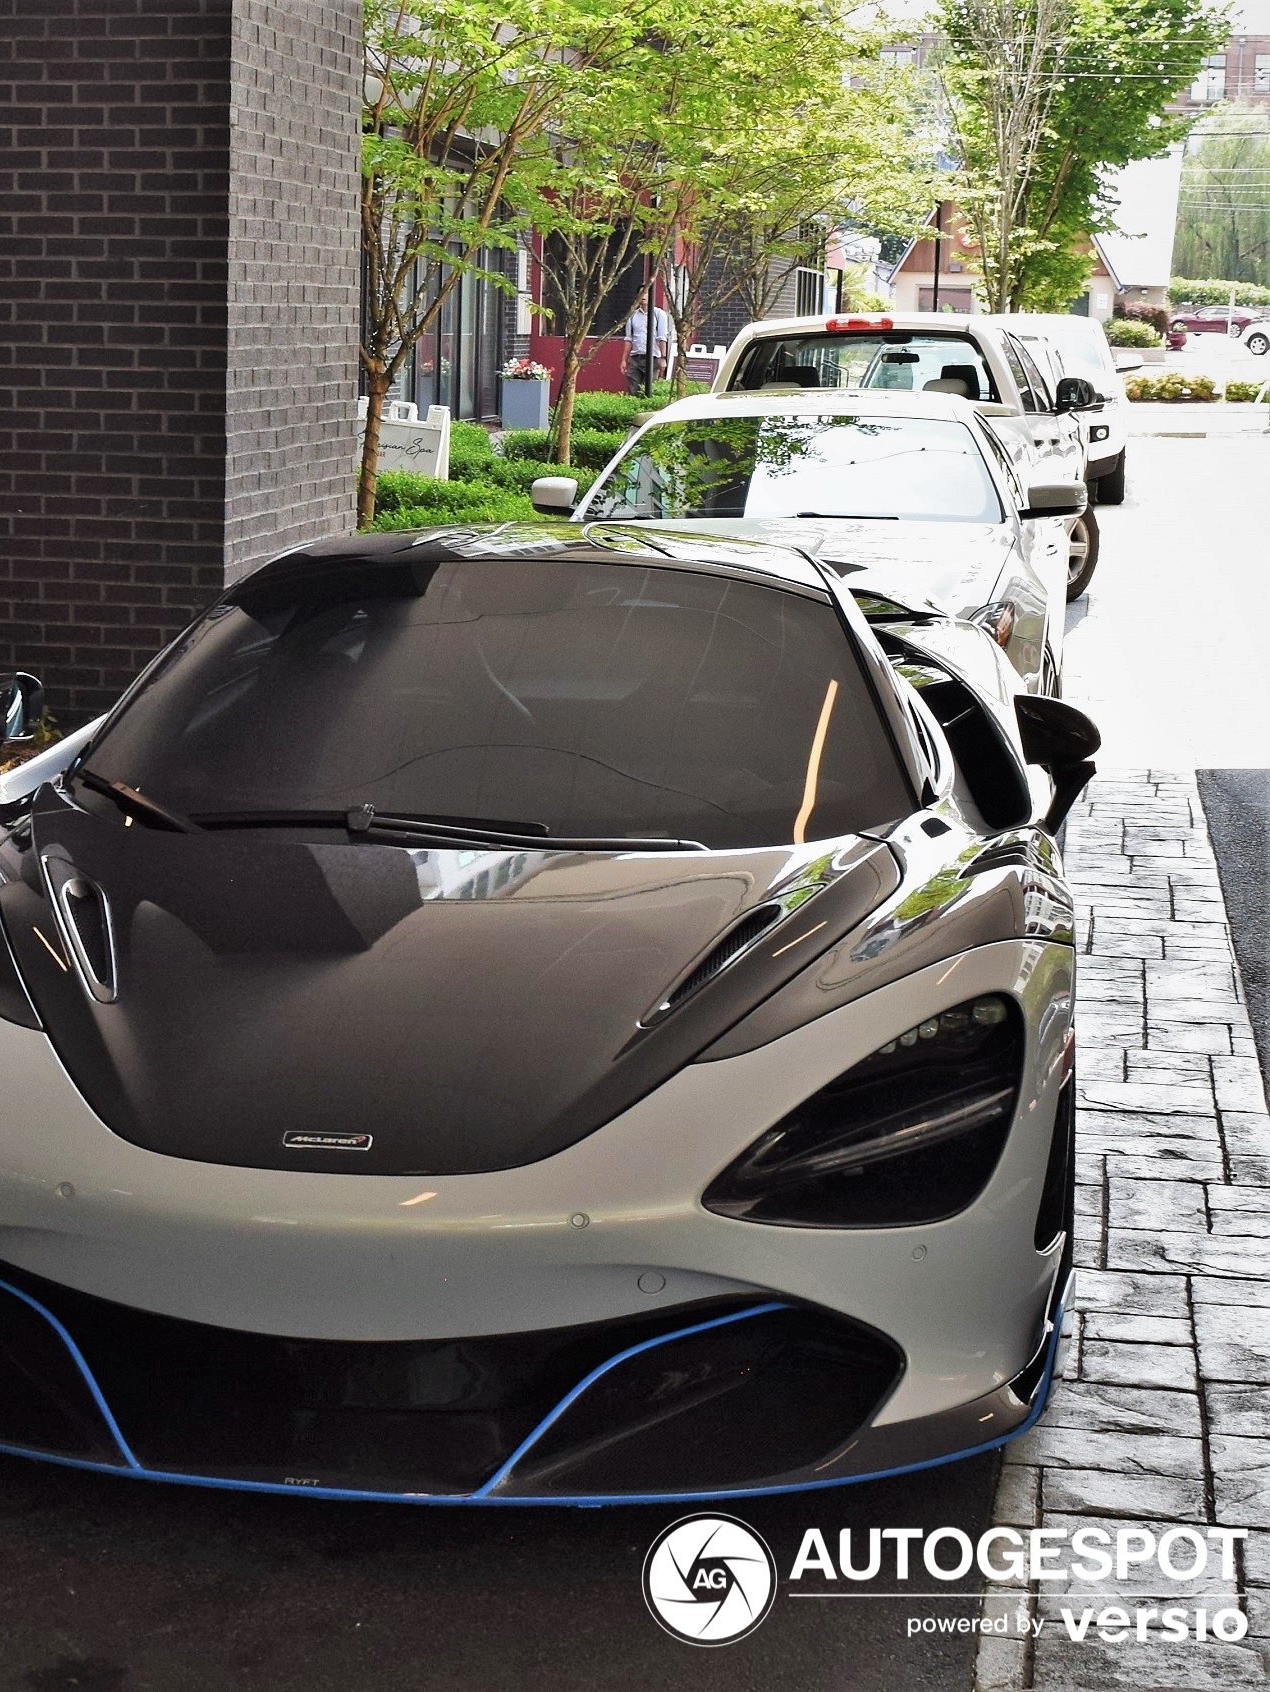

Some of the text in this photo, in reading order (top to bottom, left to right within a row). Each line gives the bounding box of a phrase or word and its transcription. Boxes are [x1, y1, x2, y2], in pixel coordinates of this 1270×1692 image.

[405, 437, 434, 459] Spa
[290, 1135, 358, 1145] McLaren
[284, 1477, 319, 1486] RYFT
